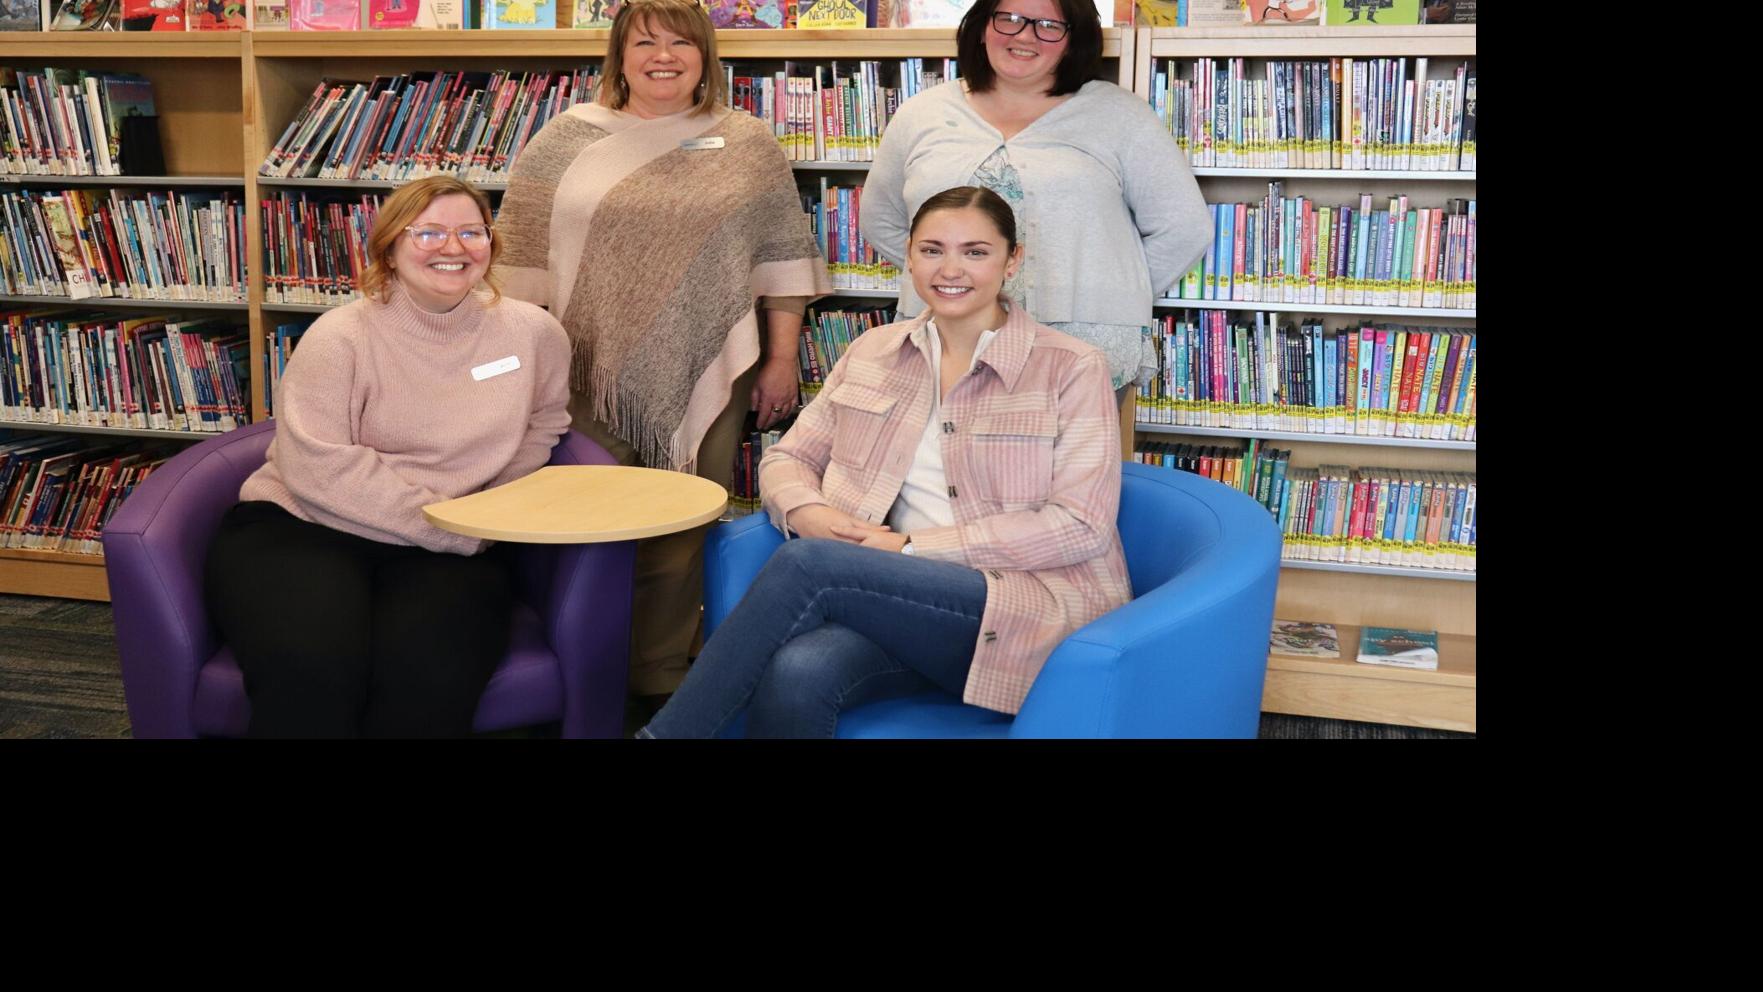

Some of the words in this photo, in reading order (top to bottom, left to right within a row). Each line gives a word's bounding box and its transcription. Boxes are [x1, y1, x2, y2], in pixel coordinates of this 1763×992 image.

[808, 8, 831, 21] NEXT
[834, 8, 856, 20] DOOR
[1413, 368, 1424, 393] NATE
[1431, 370, 1442, 394] NATE
